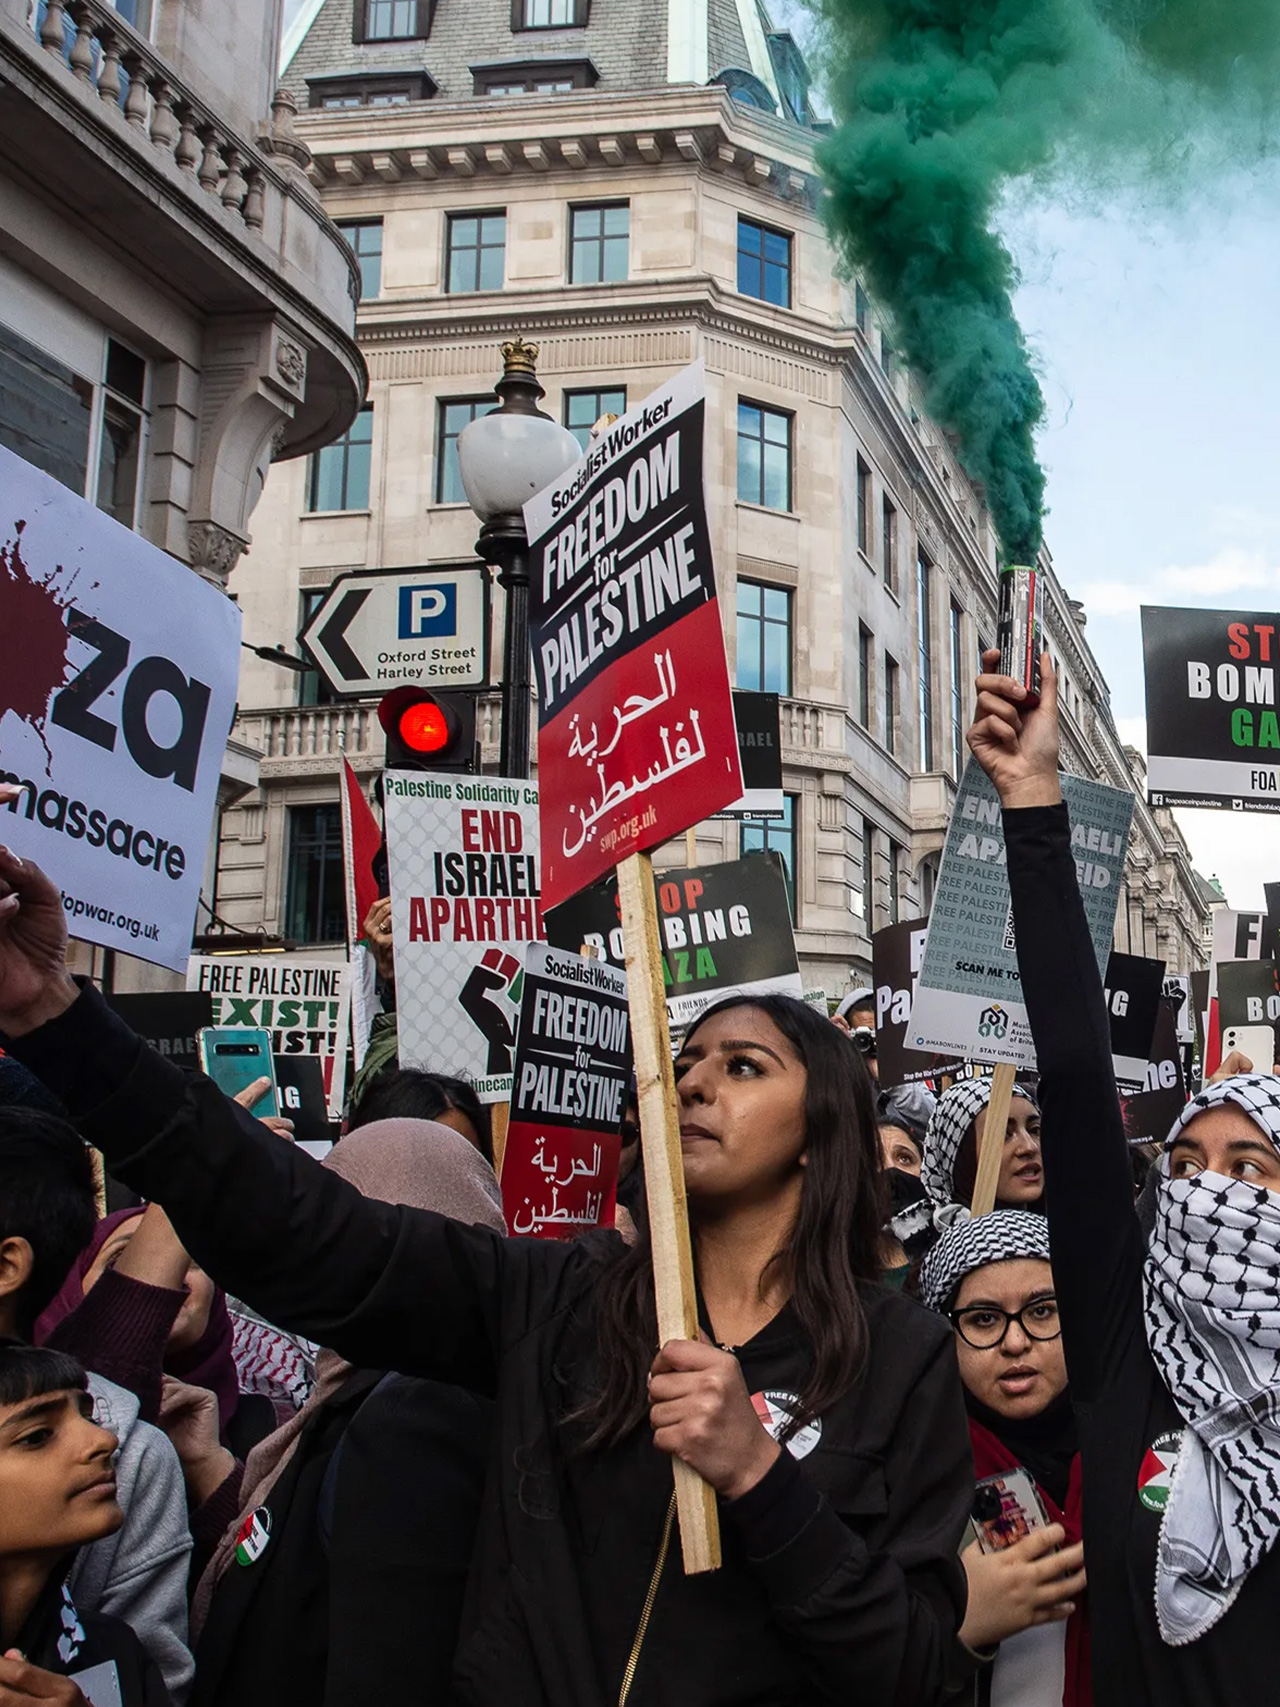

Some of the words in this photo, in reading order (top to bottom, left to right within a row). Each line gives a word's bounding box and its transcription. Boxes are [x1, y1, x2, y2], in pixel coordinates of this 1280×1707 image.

[551, 443, 608, 518] Socialist
[607, 397, 673, 459] Worker
[543, 430, 681, 604] FREEDOM
[593, 549, 618, 586] for
[411, 589, 447, 633] P
[540, 521, 702, 711] PALESTINE
[377, 666, 423, 679] Harley
[428, 663, 472, 676] Street
[378, 650, 426, 664] Oxford
[431, 647, 476, 660] Street
[568, 648, 677, 767] الحرية
[738, 732, 773, 747] RAEL
[386, 778, 452, 800] Palestine
[456, 783, 520, 806] Solidarity
[562, 708, 706, 858] لفلسطين
[1251, 771, 1277, 792] FOA
[461, 808, 522, 853] END
[600, 804, 658, 853] swp.org.uk
[1071, 824, 1123, 857] AELI
[433, 851, 541, 897] ISRAEL
[60, 890, 161, 942] topwar.org.uk
[409, 897, 547, 942] APARTHE
[584, 904, 752, 963] BOBING
[200, 964, 244, 993] FREE
[252, 967, 341, 996] PALESTINE
[545, 955, 593, 985] Socialist
[593, 967, 625, 995] Worker
[662, 946, 718, 987] AZA
[955, 961, 984, 975] SCAN
[987, 967, 1003, 979] ME
[1007, 971, 1020, 980] TO
[532, 988, 628, 1054] FREEDOM
[1011, 1020, 1030, 1030] Musli
[273, 1031, 336, 1055] IST!
[574, 1045, 591, 1069] for
[979, 1047, 996, 1056] STAY
[997, 1048, 1025, 1059] UPDATED
[518, 1061, 625, 1123] PALESTINE
[531, 1136, 601, 1186] الحرية
[513, 1187, 602, 1234] لفلسطين
[764, 1391, 788, 1400] FREE
